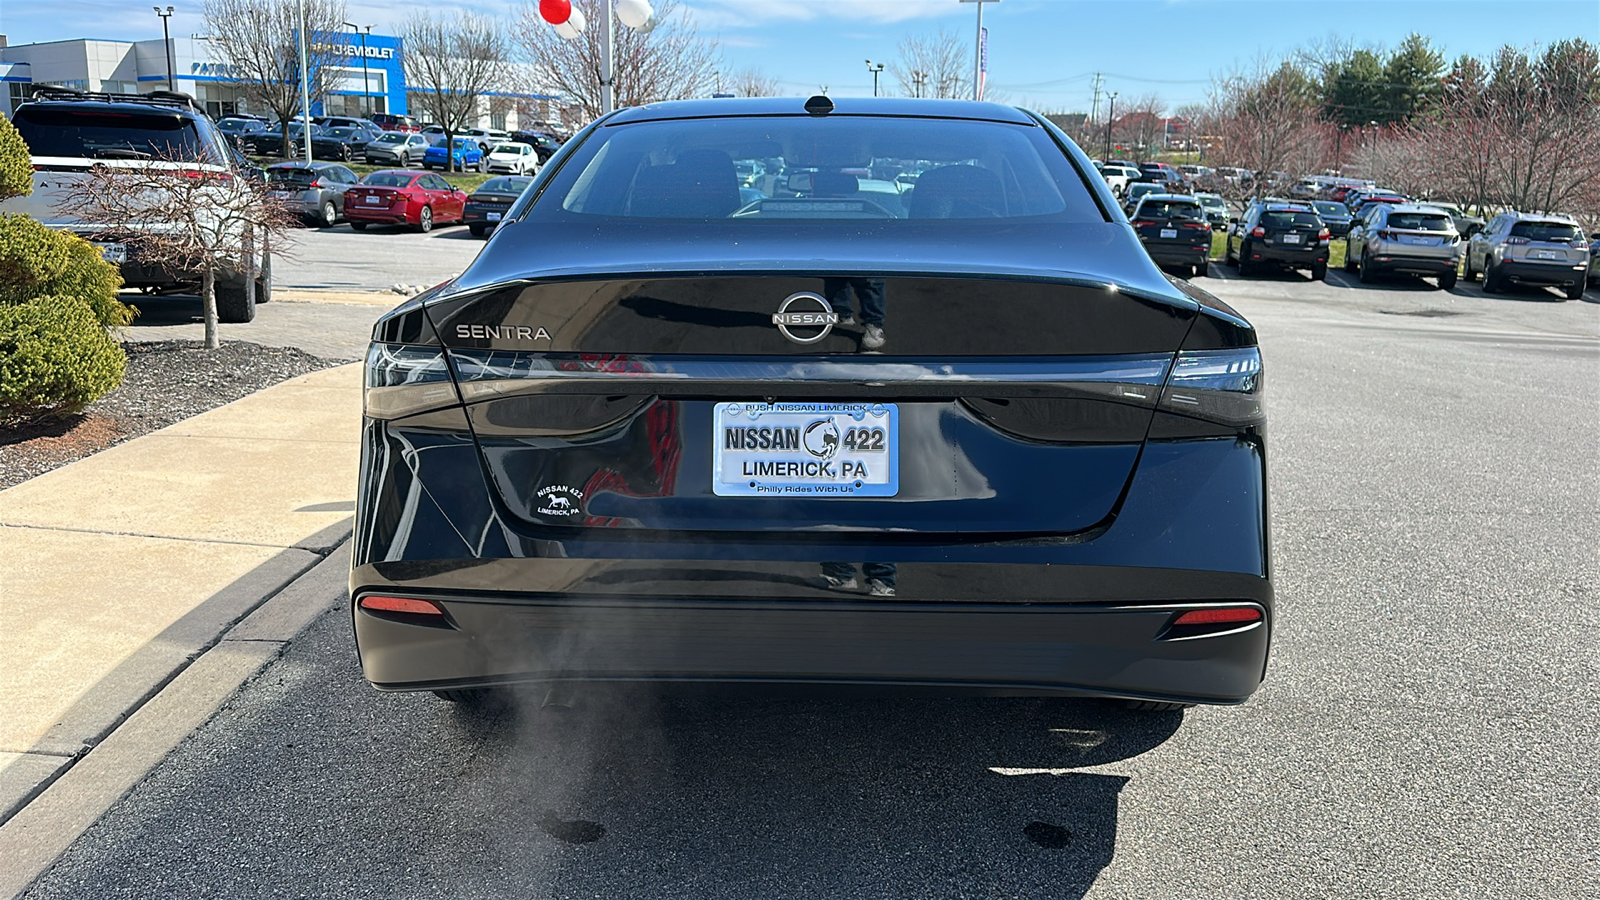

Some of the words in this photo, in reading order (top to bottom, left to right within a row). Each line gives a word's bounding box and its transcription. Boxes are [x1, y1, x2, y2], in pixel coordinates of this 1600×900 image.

[774, 314, 837, 323] NISSAN
[456, 324, 552, 341] SENTRA
[745, 404, 774, 412] BUSH
[777, 404, 817, 412] NISSAN
[818, 404, 867, 412] LIMERICK
[725, 427, 800, 450] NISSAN
[843, 427, 885, 450] 422
[742, 461, 837, 478] LIMERICK,
[841, 461, 867, 477] PA
[537, 486, 568, 497] NISSAN
[570, 488, 583, 499] 422
[756, 485, 782, 494] Philly
[785, 485, 812, 493] Rides
[814, 485, 837, 493] With
[840, 485, 854, 493] Us
[537, 507, 570, 516] LIMERICK,
